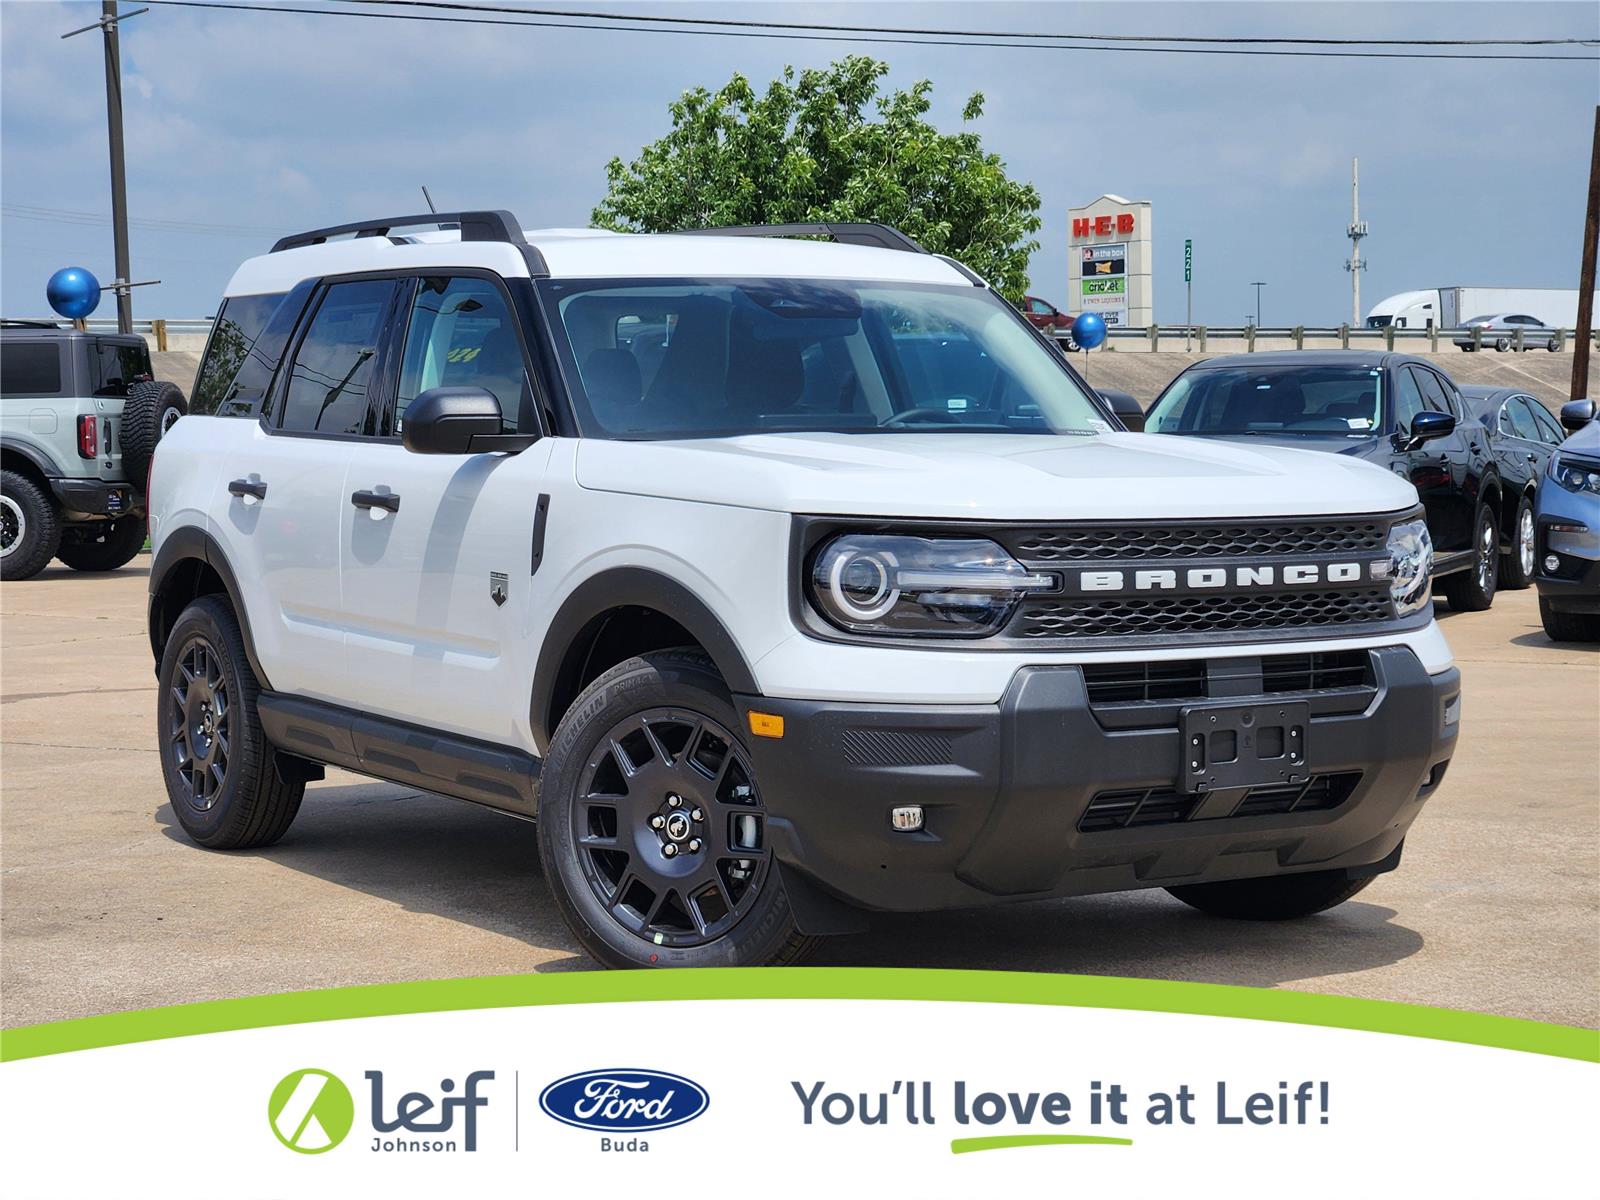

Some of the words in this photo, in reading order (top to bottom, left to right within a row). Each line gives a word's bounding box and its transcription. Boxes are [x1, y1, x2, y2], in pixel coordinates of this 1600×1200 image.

[1101, 249, 1112, 257] the
[1112, 247, 1124, 257] box
[1088, 279, 1119, 293] cricket
[1080, 563, 1361, 591] BRONCO
